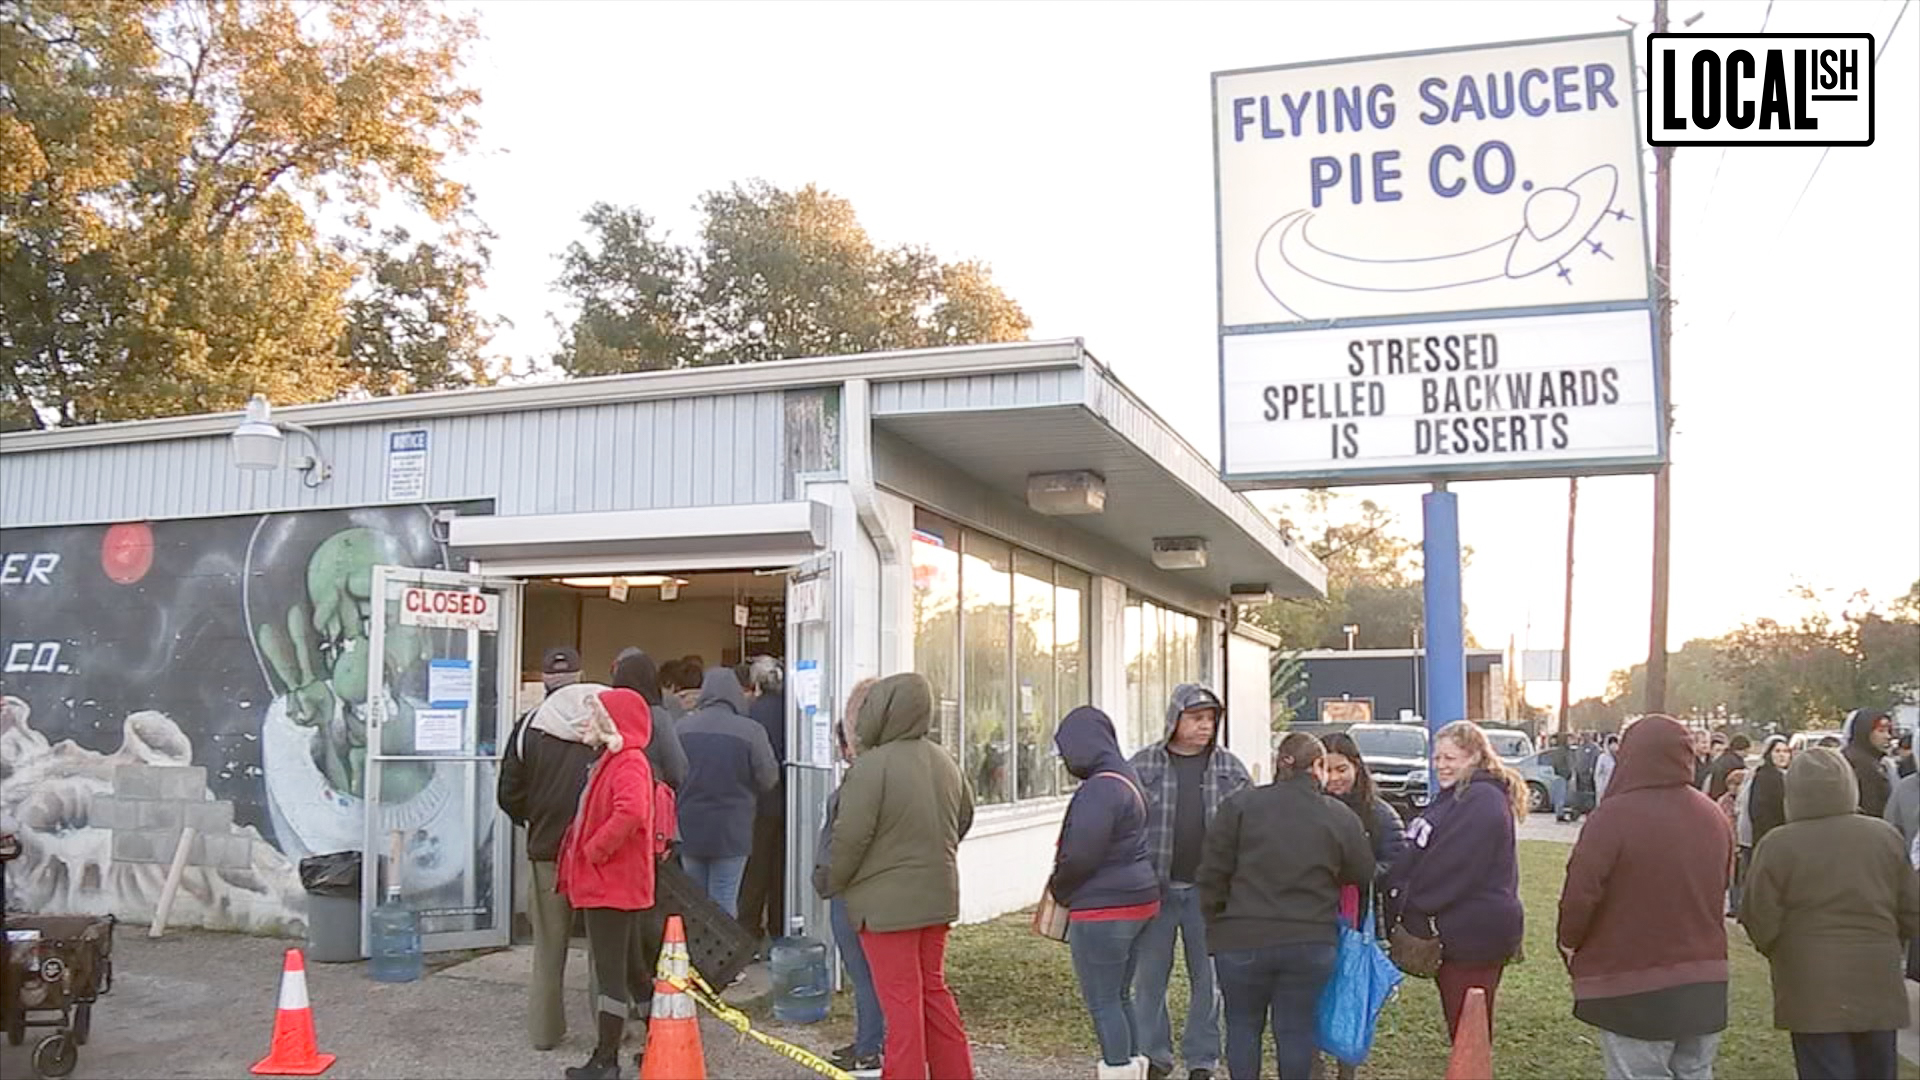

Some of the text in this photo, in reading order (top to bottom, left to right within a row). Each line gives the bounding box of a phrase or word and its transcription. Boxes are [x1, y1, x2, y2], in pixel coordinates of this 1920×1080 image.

[1234, 63, 1619, 142] FLYING SAUCER
[1310, 140, 1534, 208] PIE CO.
[1347, 333, 1498, 376] STRESSED
[1263, 368, 1619, 421] SPELLED BACKWARDS
[1331, 414, 1569, 459] IS DESSERTS
[406, 590, 487, 614] CLOSED
